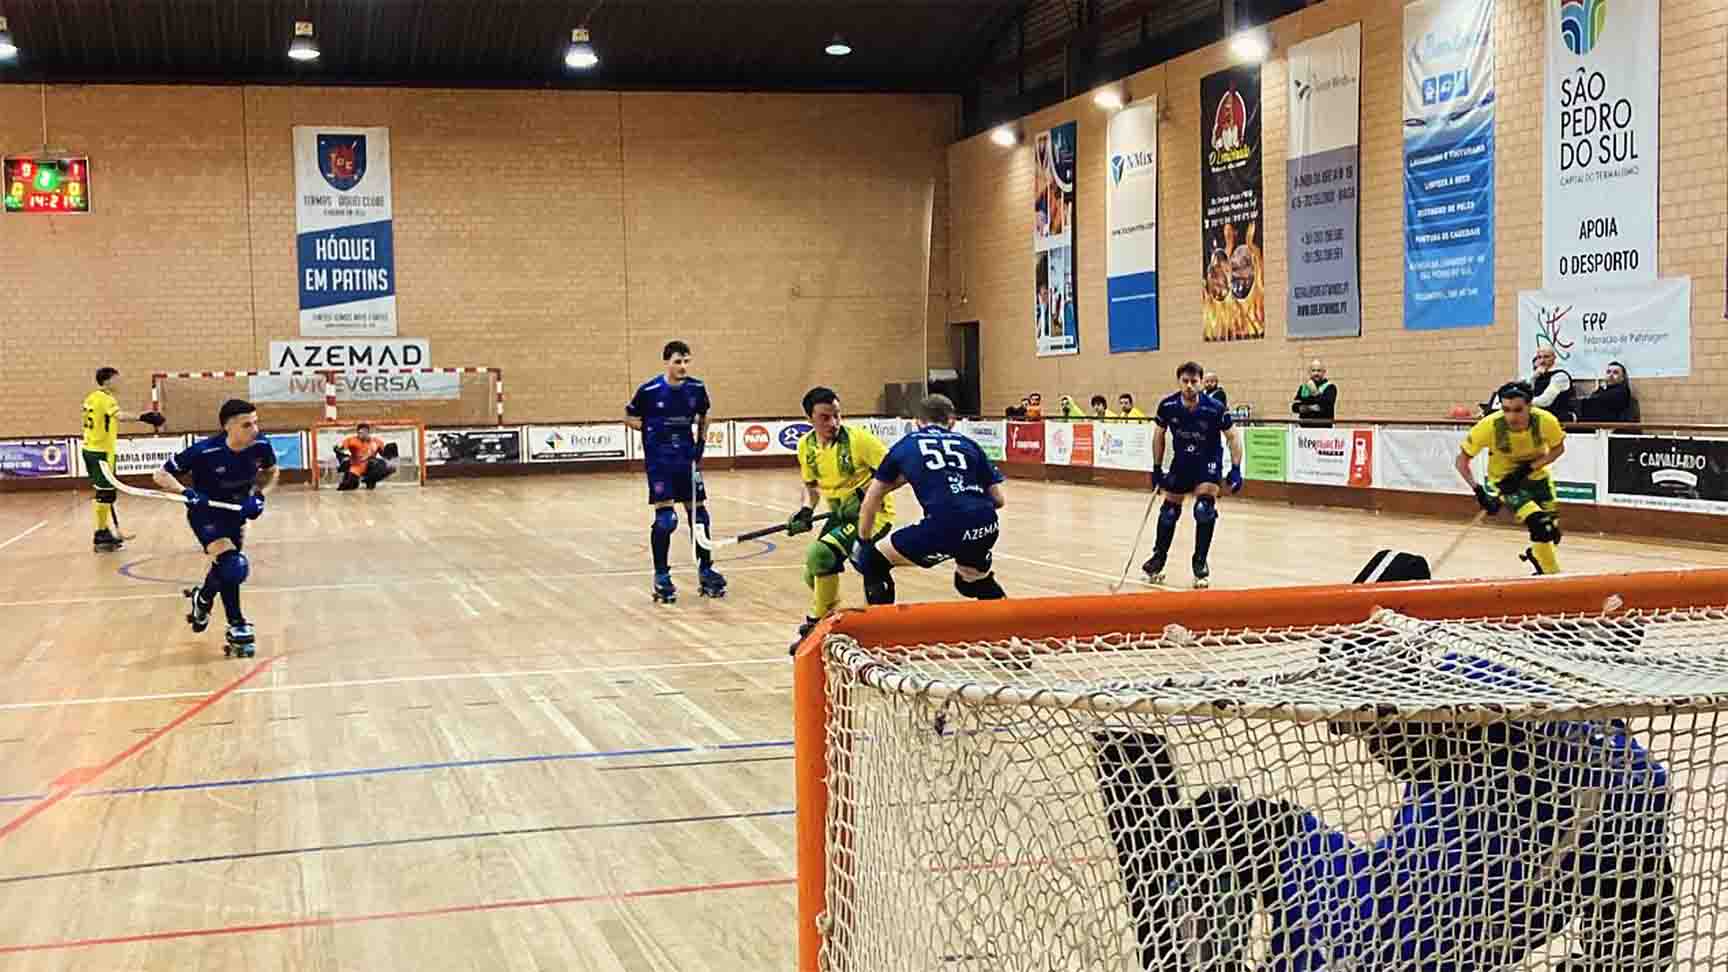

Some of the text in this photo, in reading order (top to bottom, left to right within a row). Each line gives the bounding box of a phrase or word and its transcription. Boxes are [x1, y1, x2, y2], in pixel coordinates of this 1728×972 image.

[1561, 67, 1605, 107] SÃO
[1561, 99, 1632, 139] PEDRO
[1561, 131, 1639, 170] DO SUL
[1579, 217, 1618, 239] APOIA
[316, 234, 375, 261] HÓQUEI
[1560, 250, 1639, 275] O DESPORTO
[305, 268, 389, 291] EM PATINS
[1582, 312, 1607, 331] FPP
[279, 345, 422, 367] AZEMAD
[918, 438, 968, 471] 55
